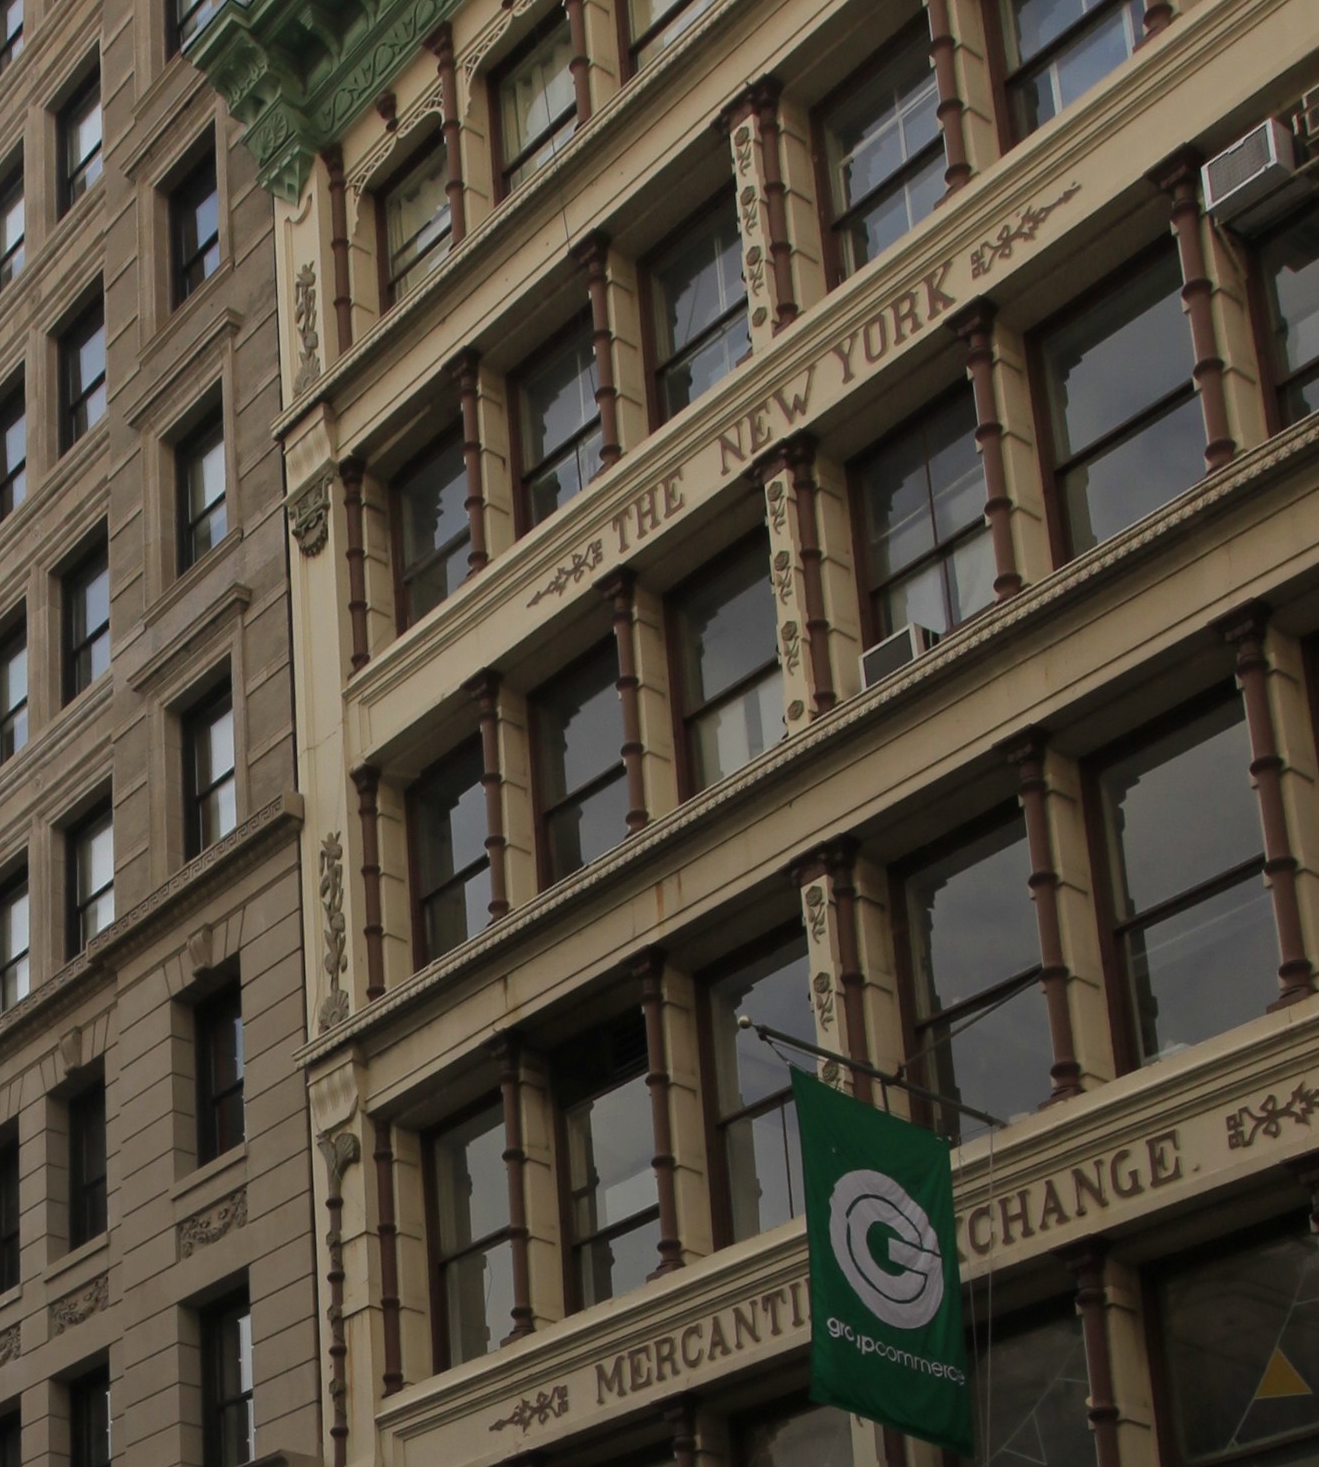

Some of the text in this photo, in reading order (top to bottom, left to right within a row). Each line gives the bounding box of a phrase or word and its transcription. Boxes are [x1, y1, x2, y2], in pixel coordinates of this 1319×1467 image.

[612, 260, 957, 554] THE NEW YORK
[595, 1277, 812, 1405] MERCANTI
